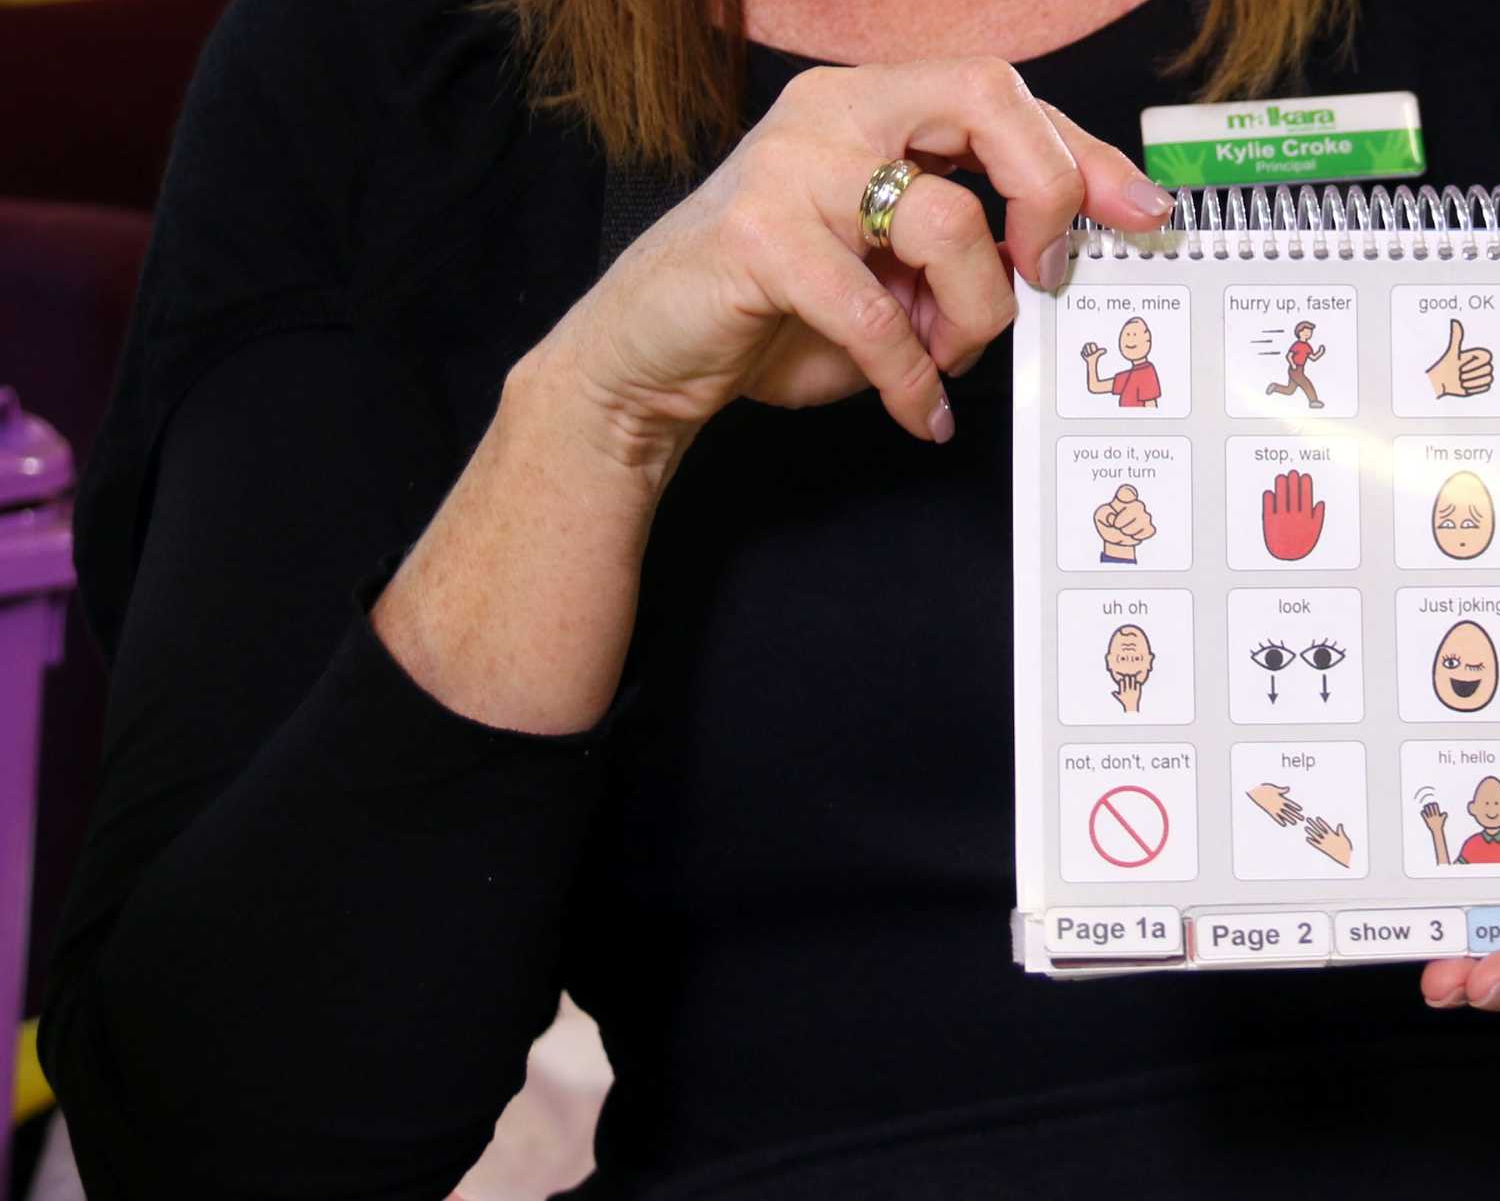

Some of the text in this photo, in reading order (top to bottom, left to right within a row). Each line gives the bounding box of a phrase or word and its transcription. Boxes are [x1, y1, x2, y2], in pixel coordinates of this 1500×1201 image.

[1227, 106, 1335, 129] mlkara
[1215, 137, 1352, 164] Kylie Croke
[1255, 159, 1316, 173] Principal
[1075, 294, 1101, 312] do,
[1106, 297, 1136, 313] me,
[1141, 294, 1182, 311] mine
[1229, 294, 1353, 315] hurry up, faster
[1418, 294, 1496, 315] good, OK
[1072, 445, 1174, 464] you do it, you,
[1254, 446, 1331, 465] stop, wait
[1425, 445, 1494, 464] I'm sorry
[1091, 465, 1156, 482] your turn
[1102, 598, 1149, 616] uh oh
[1278, 598, 1312, 615] look
[1418, 597, 1455, 614] Just
[1064, 752, 1191, 772] not, don't, can't
[1281, 751, 1316, 772] help
[1438, 750, 1496, 766] hi, hello
[1056, 916, 1167, 946] Page 1a
[1211, 922, 1314, 952] Page 2
[1349, 920, 1445, 942] show 3
